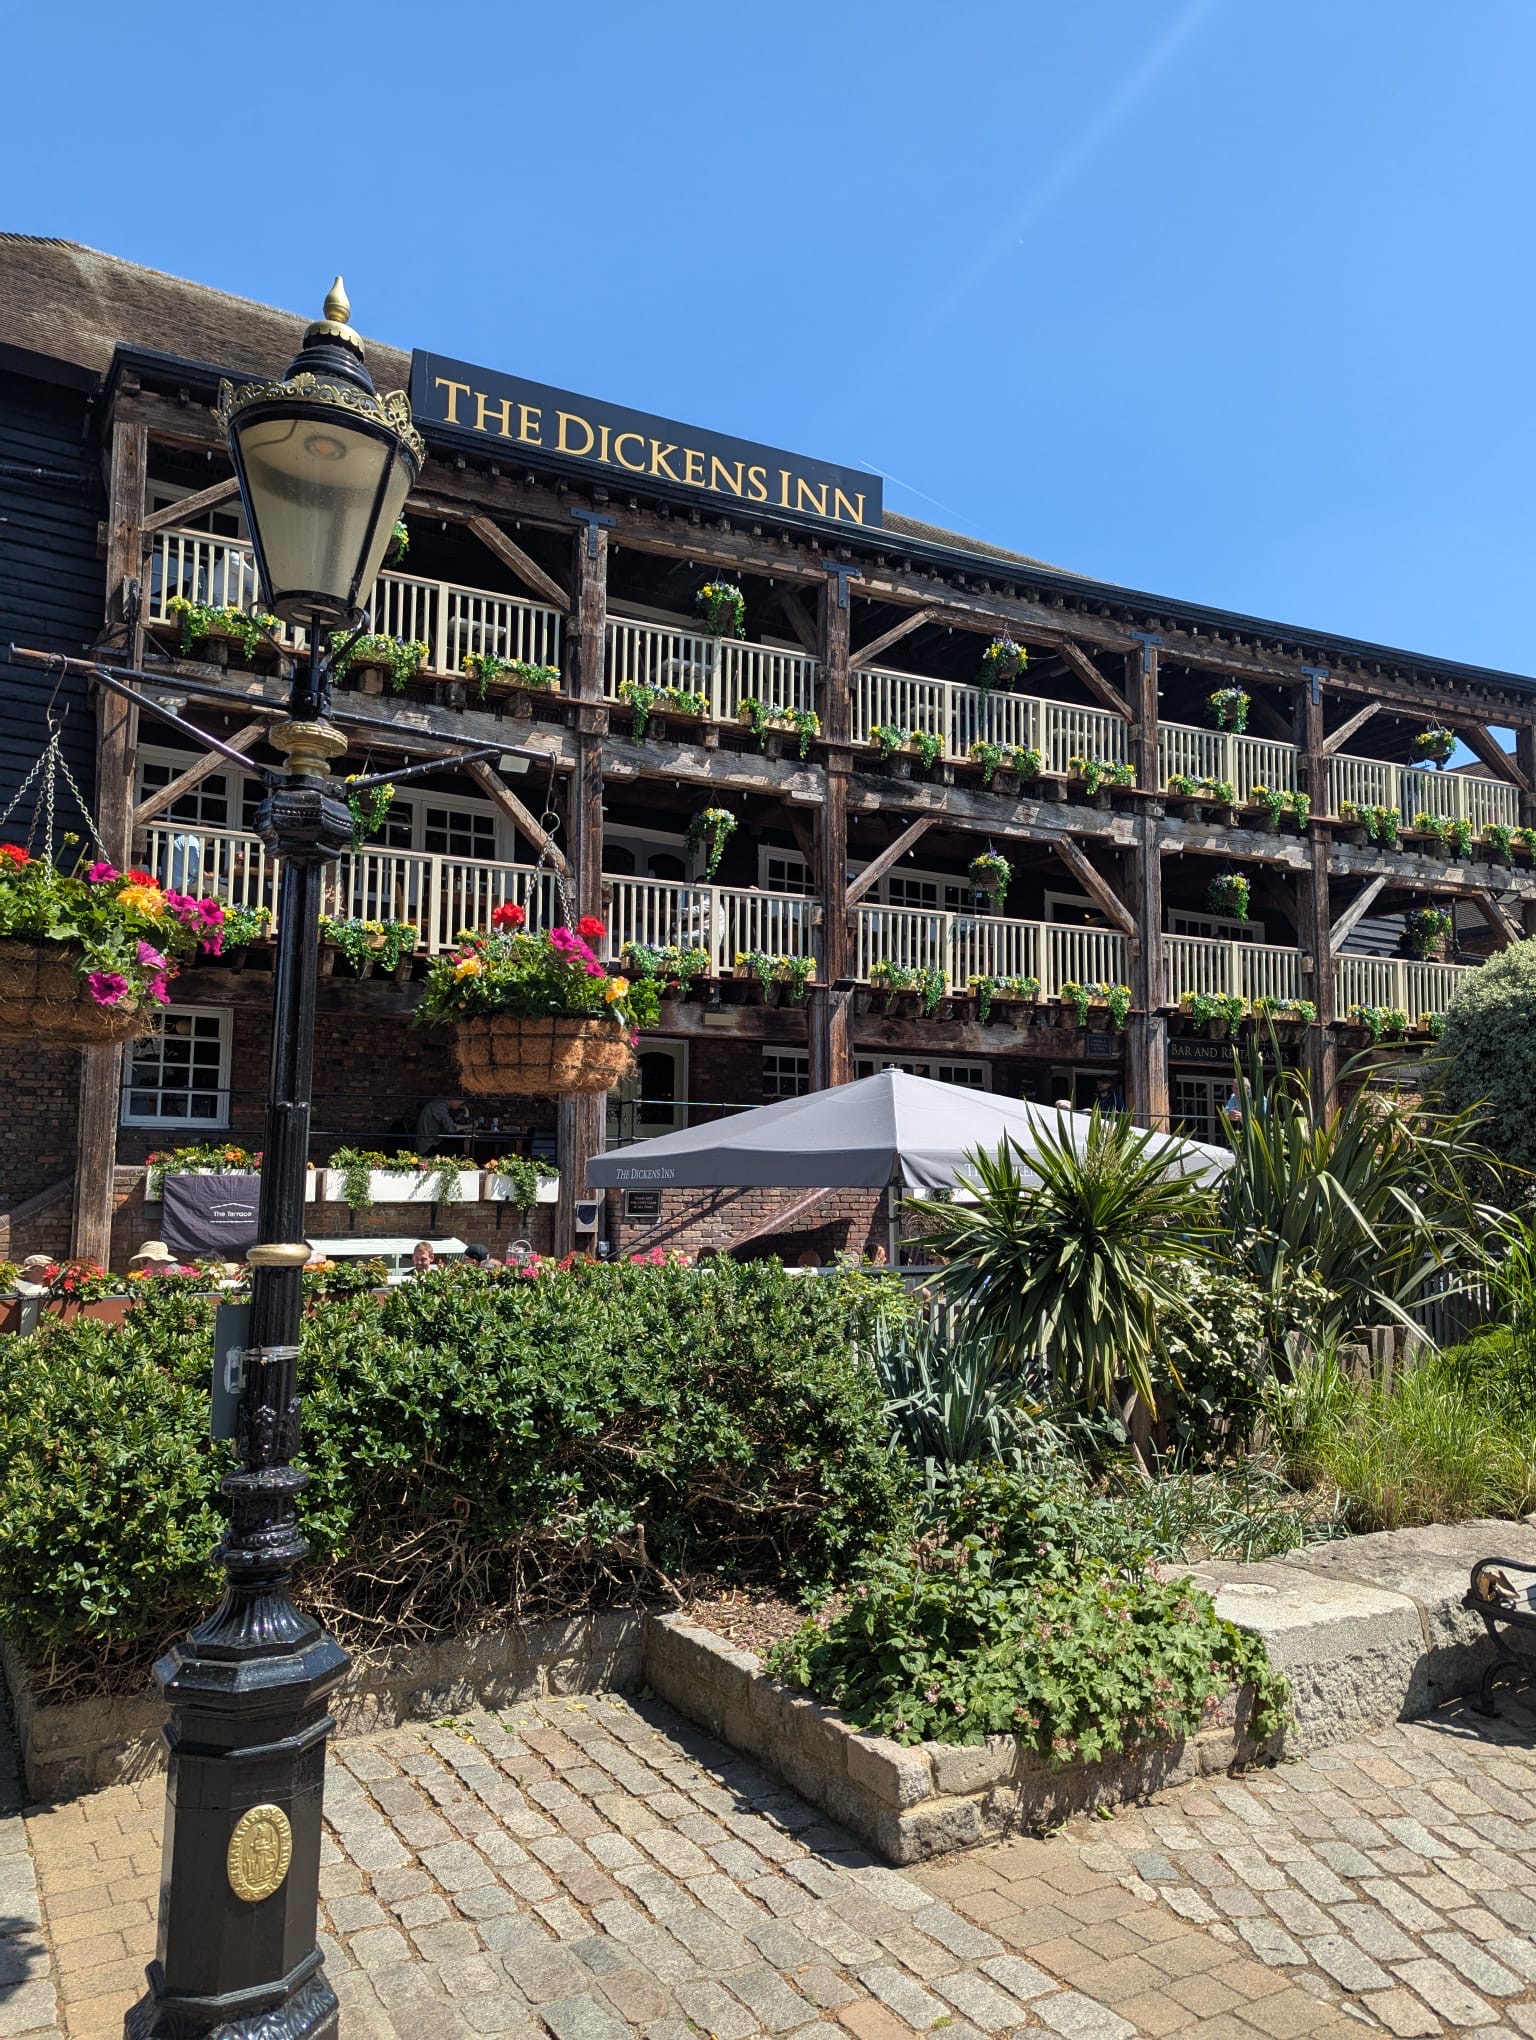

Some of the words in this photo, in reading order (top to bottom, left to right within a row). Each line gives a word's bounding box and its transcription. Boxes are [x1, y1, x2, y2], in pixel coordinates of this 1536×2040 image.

[435, 376, 543, 446] THE
[554, 410, 768, 502] DICKENS
[777, 469, 866, 526] INN
[1171, 1044, 1192, 1057] BAR
[1194, 1046, 1218, 1058] AND
[616, 1168, 631, 1180] THE
[631, 1168, 661, 1180] DICKENS
[661, 1167, 675, 1179] INN
